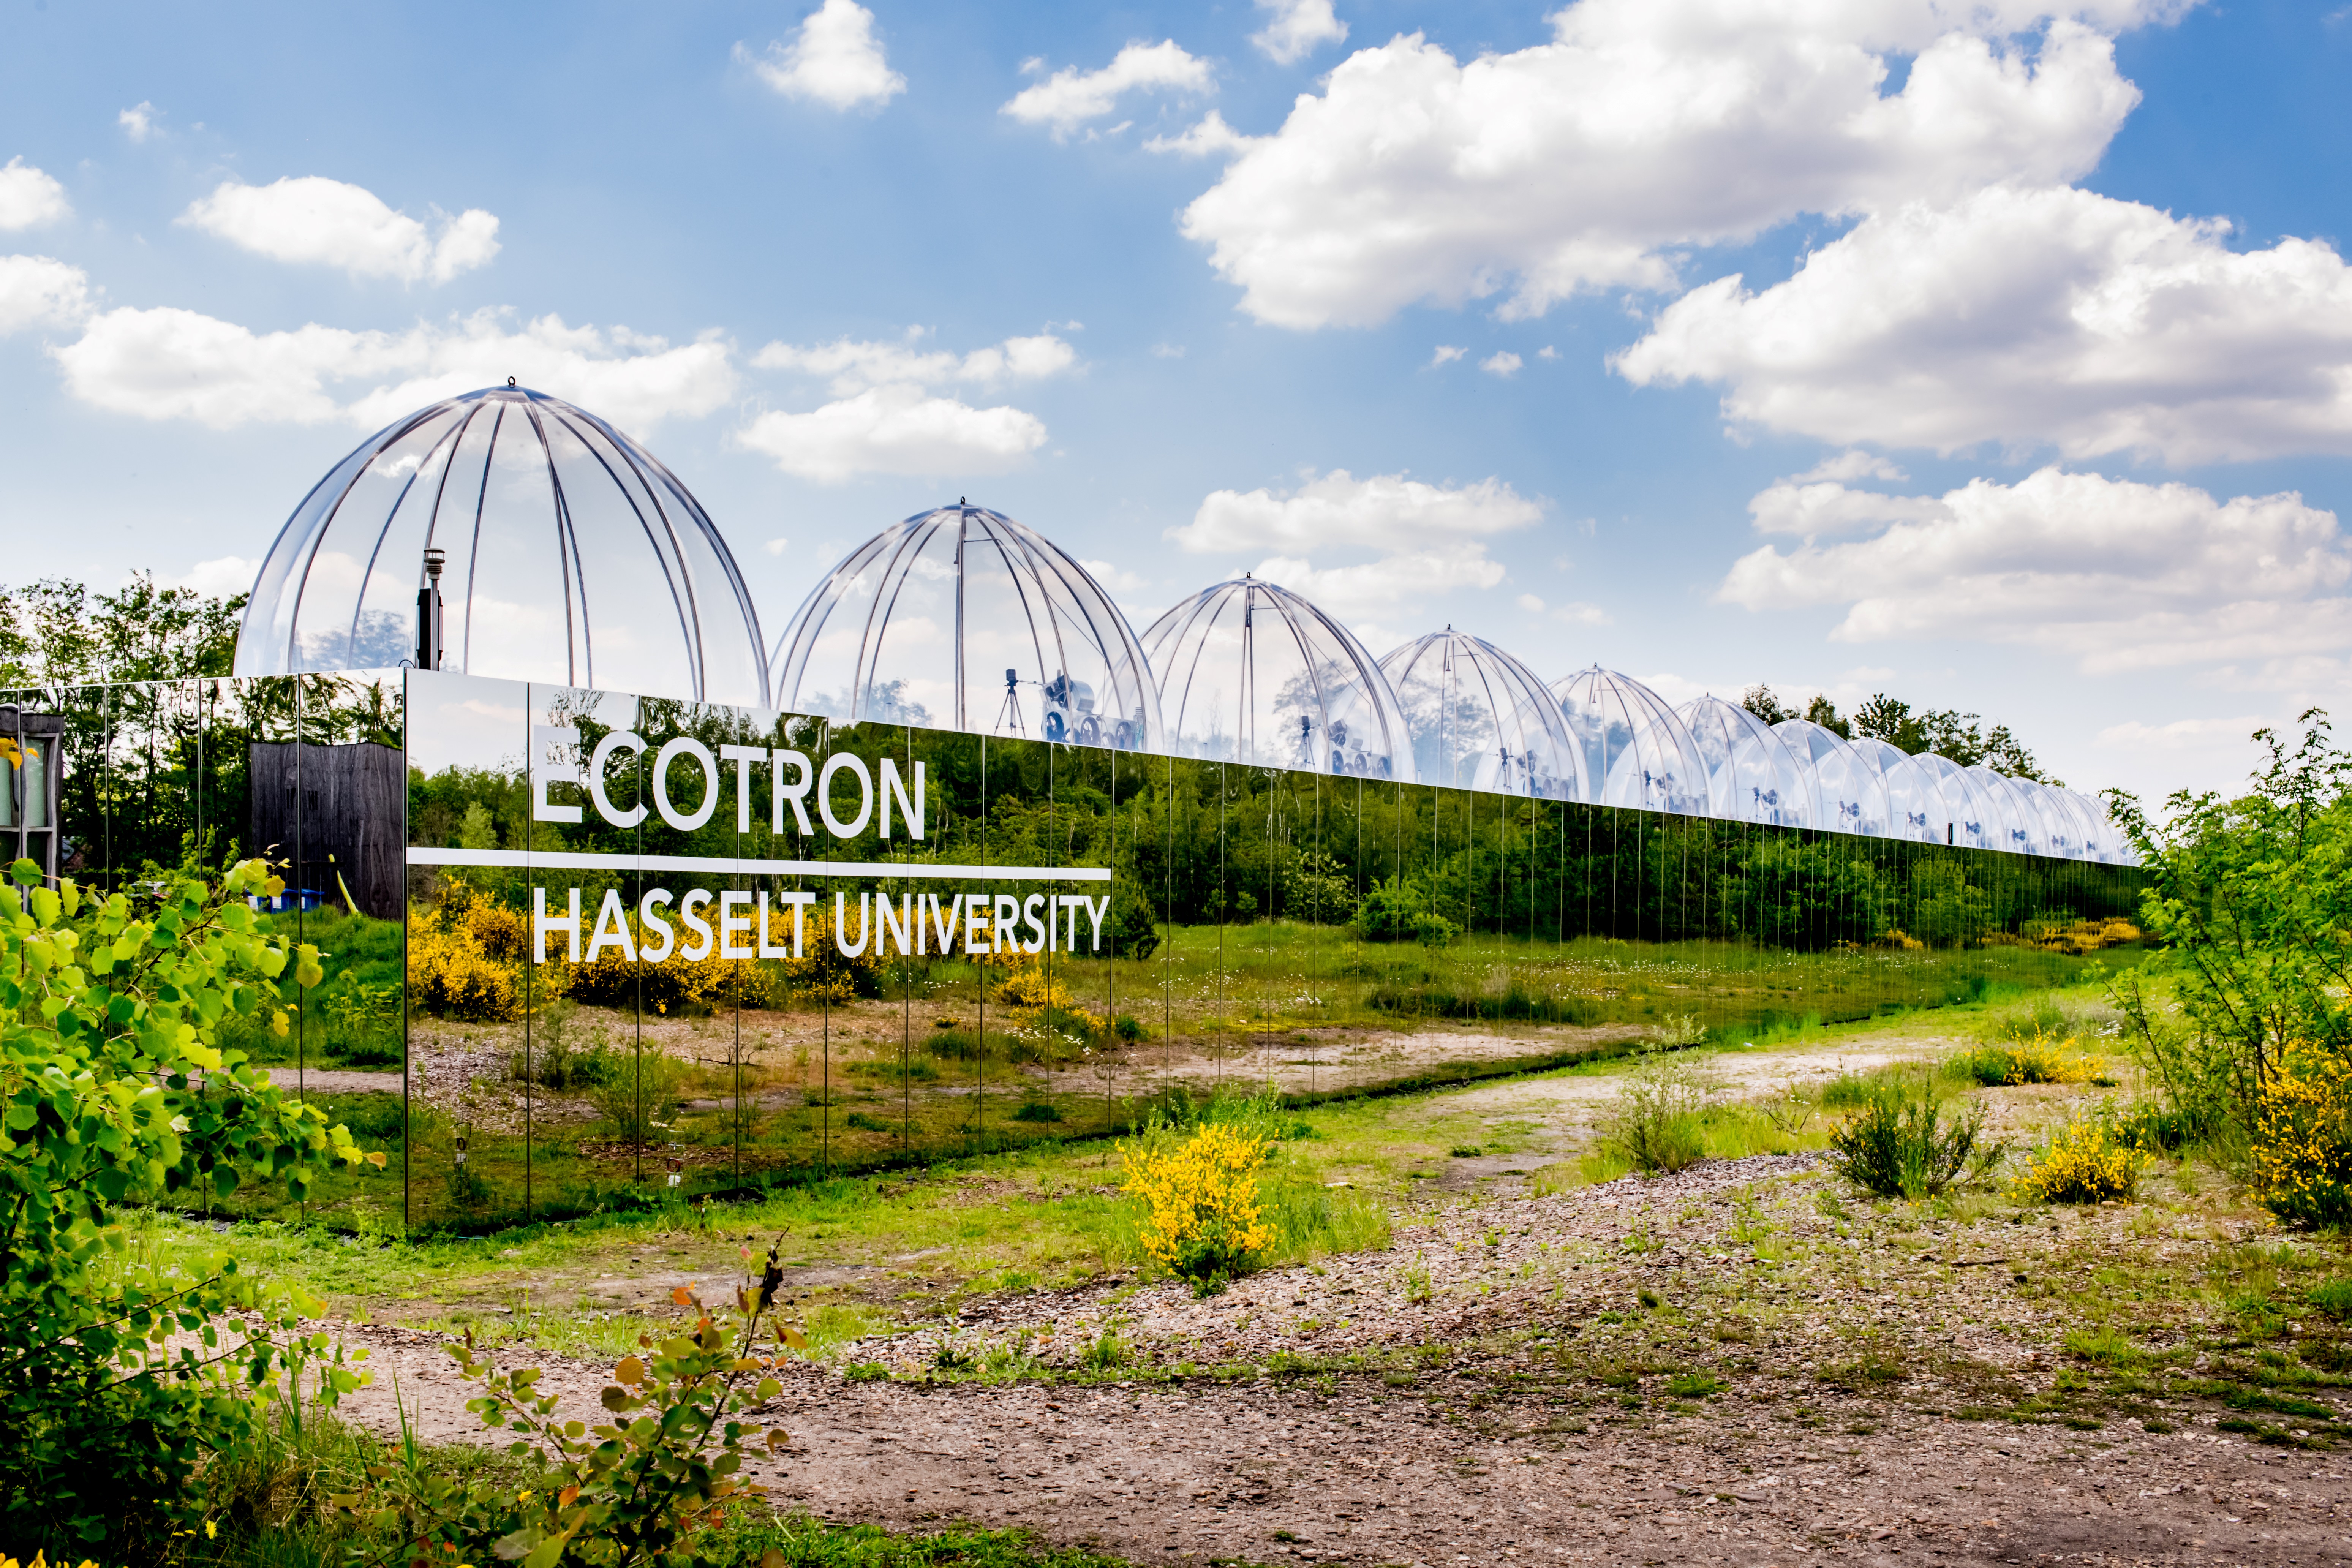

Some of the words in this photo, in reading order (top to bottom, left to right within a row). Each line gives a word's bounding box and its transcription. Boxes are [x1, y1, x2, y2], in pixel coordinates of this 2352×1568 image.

[533, 724, 925, 840] ECOTRON
[534, 887, 816, 963] HASSELT
[836, 891, 1110, 958] UNIVERSITY
